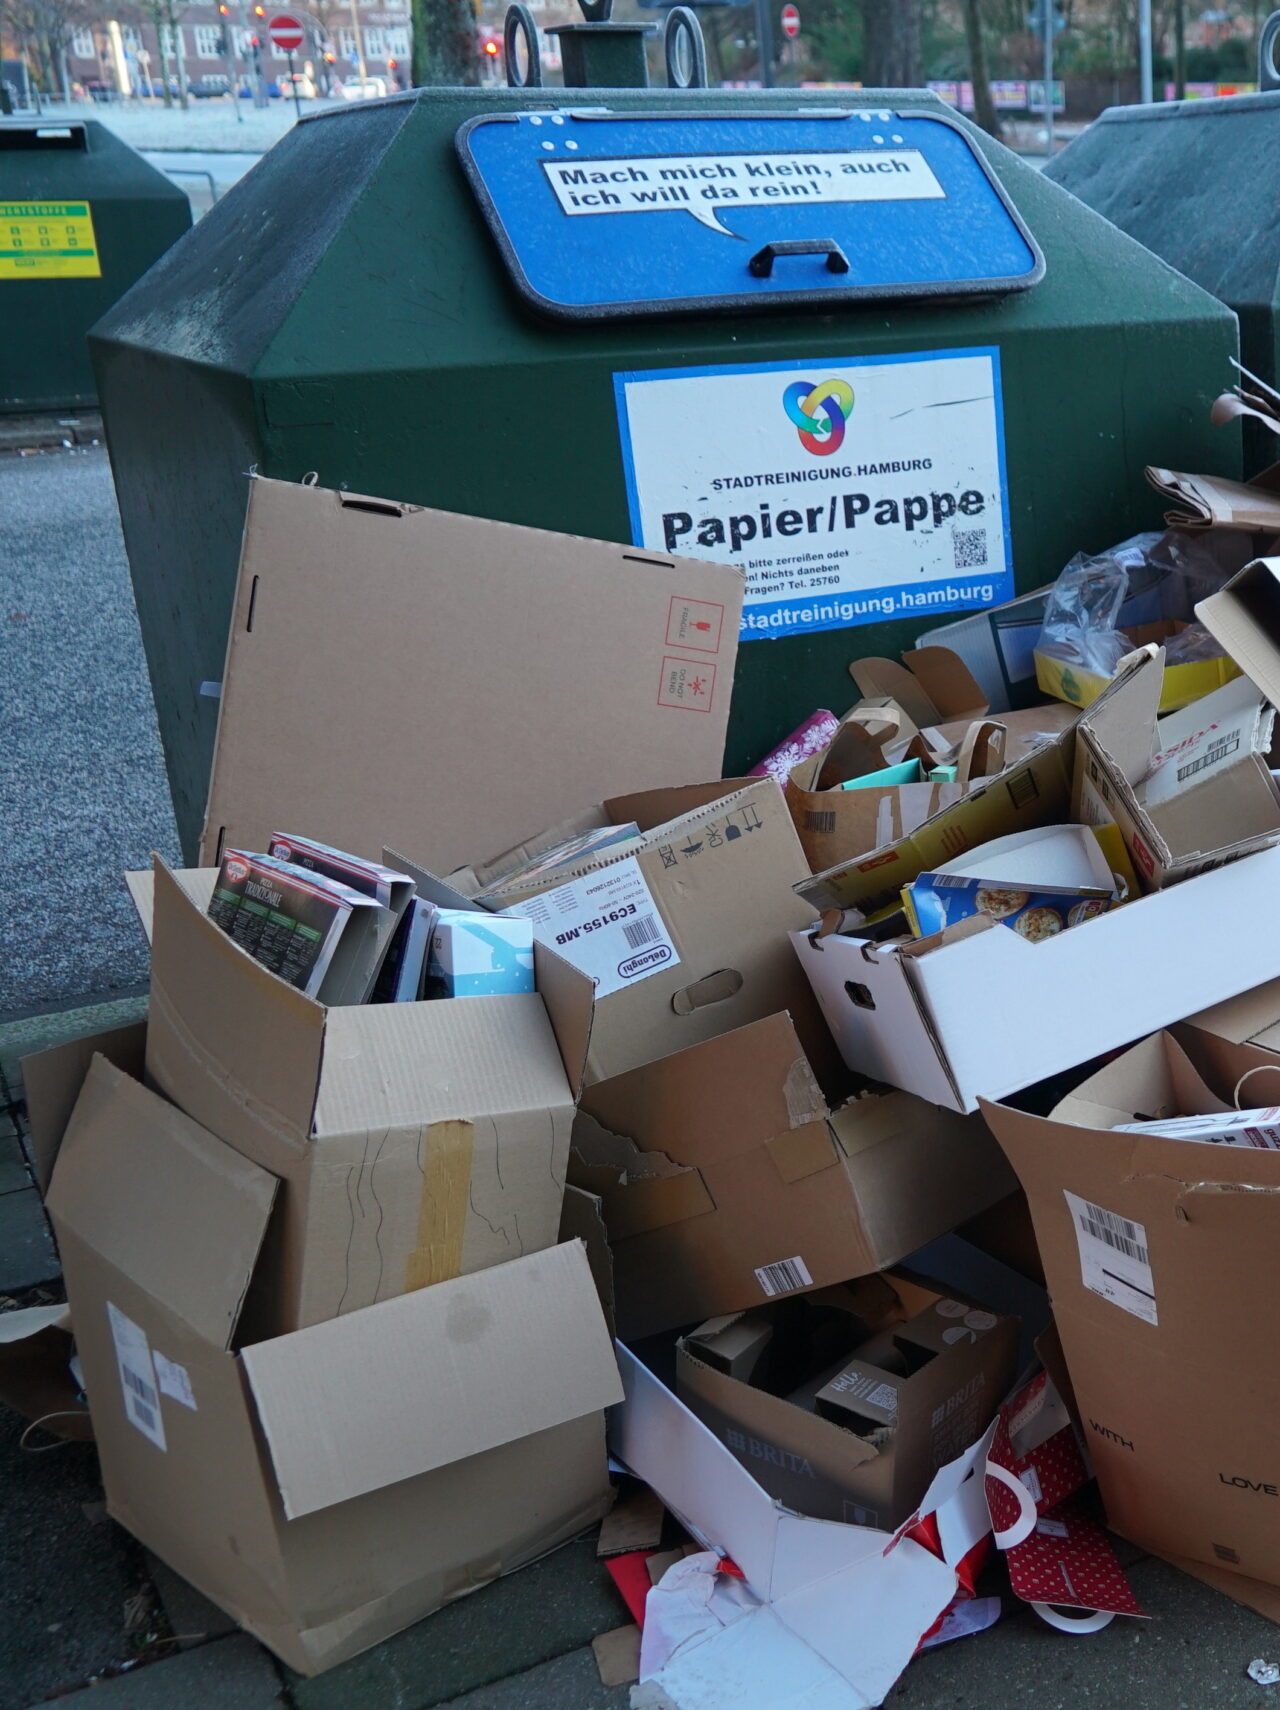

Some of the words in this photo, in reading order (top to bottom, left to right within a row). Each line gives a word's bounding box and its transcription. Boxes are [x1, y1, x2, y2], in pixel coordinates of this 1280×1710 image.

[558, 164, 648, 186] Mach
[660, 160, 737, 182] mich
[748, 157, 833, 180] klein,
[842, 157, 911, 176] auch
[567, 186, 621, 207] ich
[632, 183, 691, 203] will
[700, 180, 740, 200] da
[748, 177, 822, 198] rein!
[713, 458, 933, 491] STADTREINIGUNG.HAMBURG
[661, 488, 985, 553] Papier/Pappe
[749, 559, 773, 569] bitte
[776, 553, 824, 565] zerreißen
[761, 569, 794, 580] Nichts
[797, 564, 840, 576] daneben
[744, 582, 785, 595] Fragen?
[789, 581, 807, 590] Tel.
[810, 575, 840, 587] 25760
[739, 581, 993, 631] stadtreinigung.hamburg
[679, 607, 689, 639] FRAGILE
[669, 672, 677, 693] BEND
[260, 877, 273, 888] PIZZA
[555, 902, 637, 946] EC9155.MB
[622, 948, 667, 975] DeLonghi
[945, 1371, 985, 1415] BRITA
[1089, 1419, 1135, 1451] WITH
[750, 1438, 817, 1480] BRITA
[1218, 1473, 1279, 1496] LOVE
